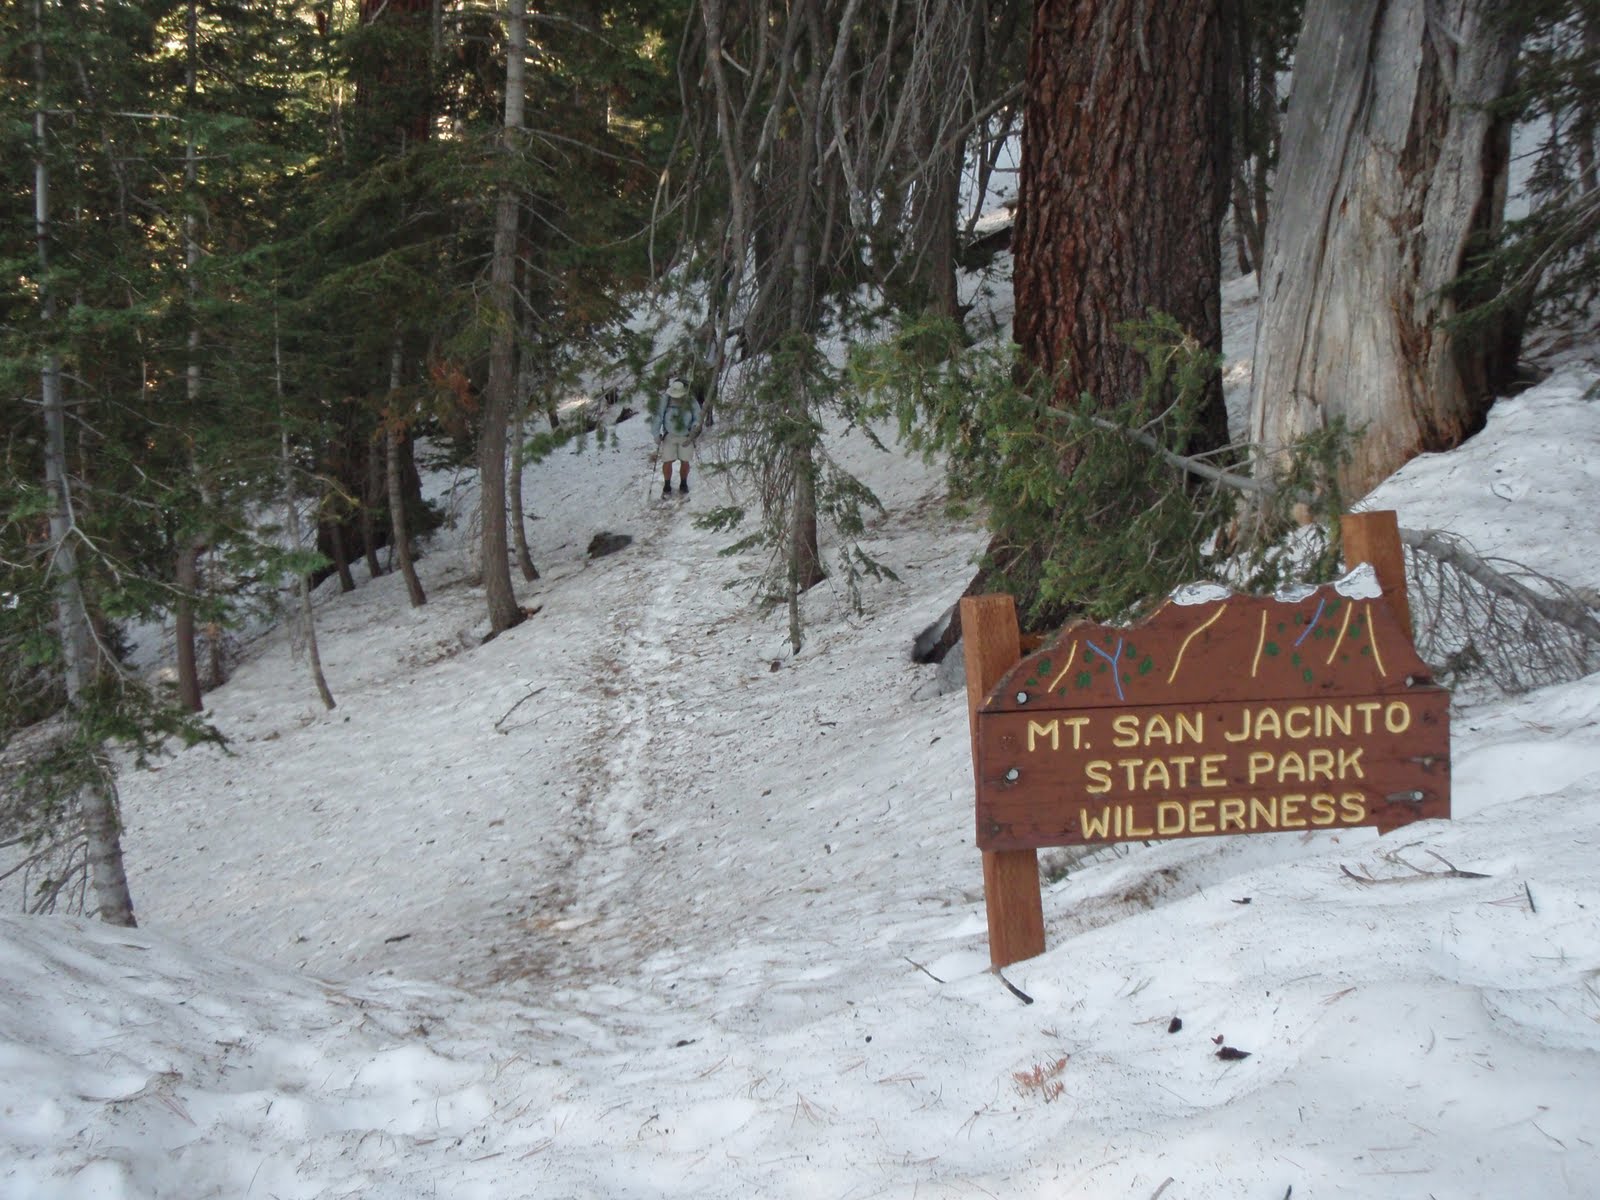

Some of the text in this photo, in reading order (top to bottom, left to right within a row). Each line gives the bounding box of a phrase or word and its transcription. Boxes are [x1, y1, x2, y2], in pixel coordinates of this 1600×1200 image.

[1027, 701, 1411, 752] MT. SAN JACINTO
[1085, 747, 1364, 793] STATE PARK
[1080, 792, 1366, 839] WILDERNESS
